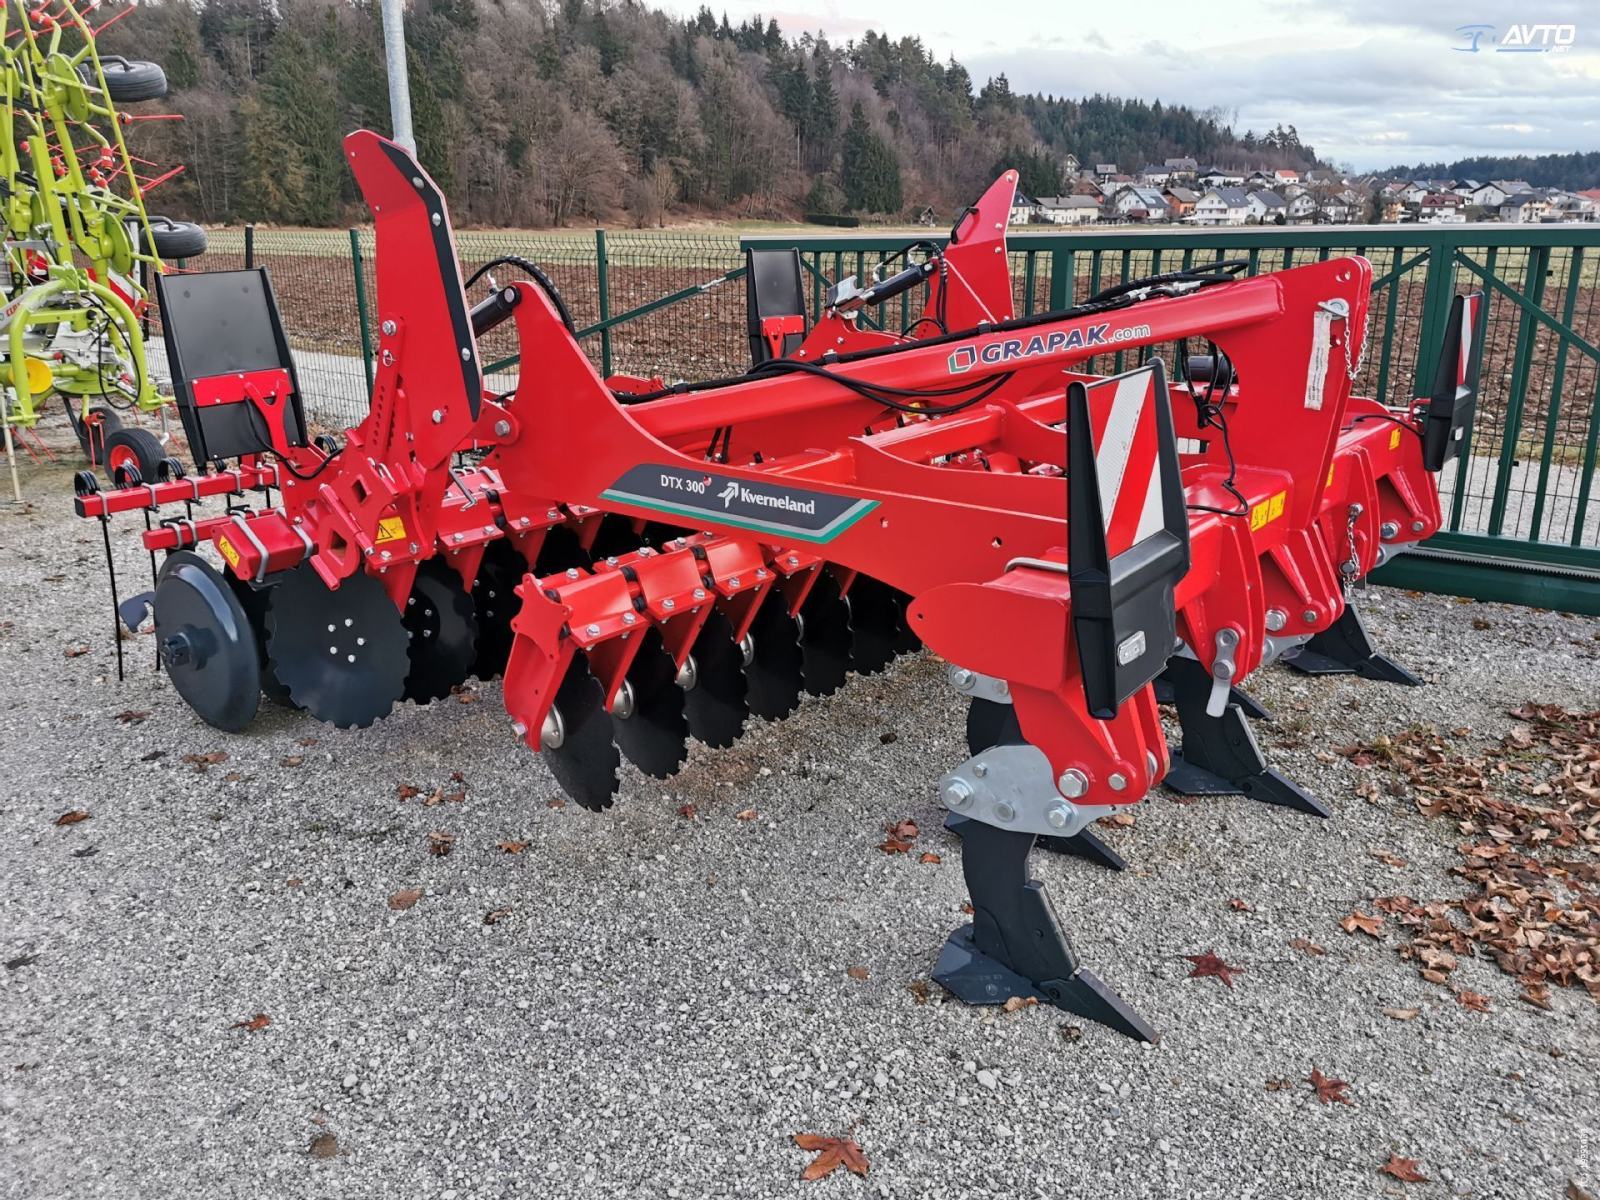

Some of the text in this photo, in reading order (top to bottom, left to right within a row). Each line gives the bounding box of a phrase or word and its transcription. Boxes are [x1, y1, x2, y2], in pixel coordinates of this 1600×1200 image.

[981, 323, 1151, 364] GRAPAK.com
[660, 474, 706, 495] DTX 300
[741, 487, 815, 515] Kverneland
